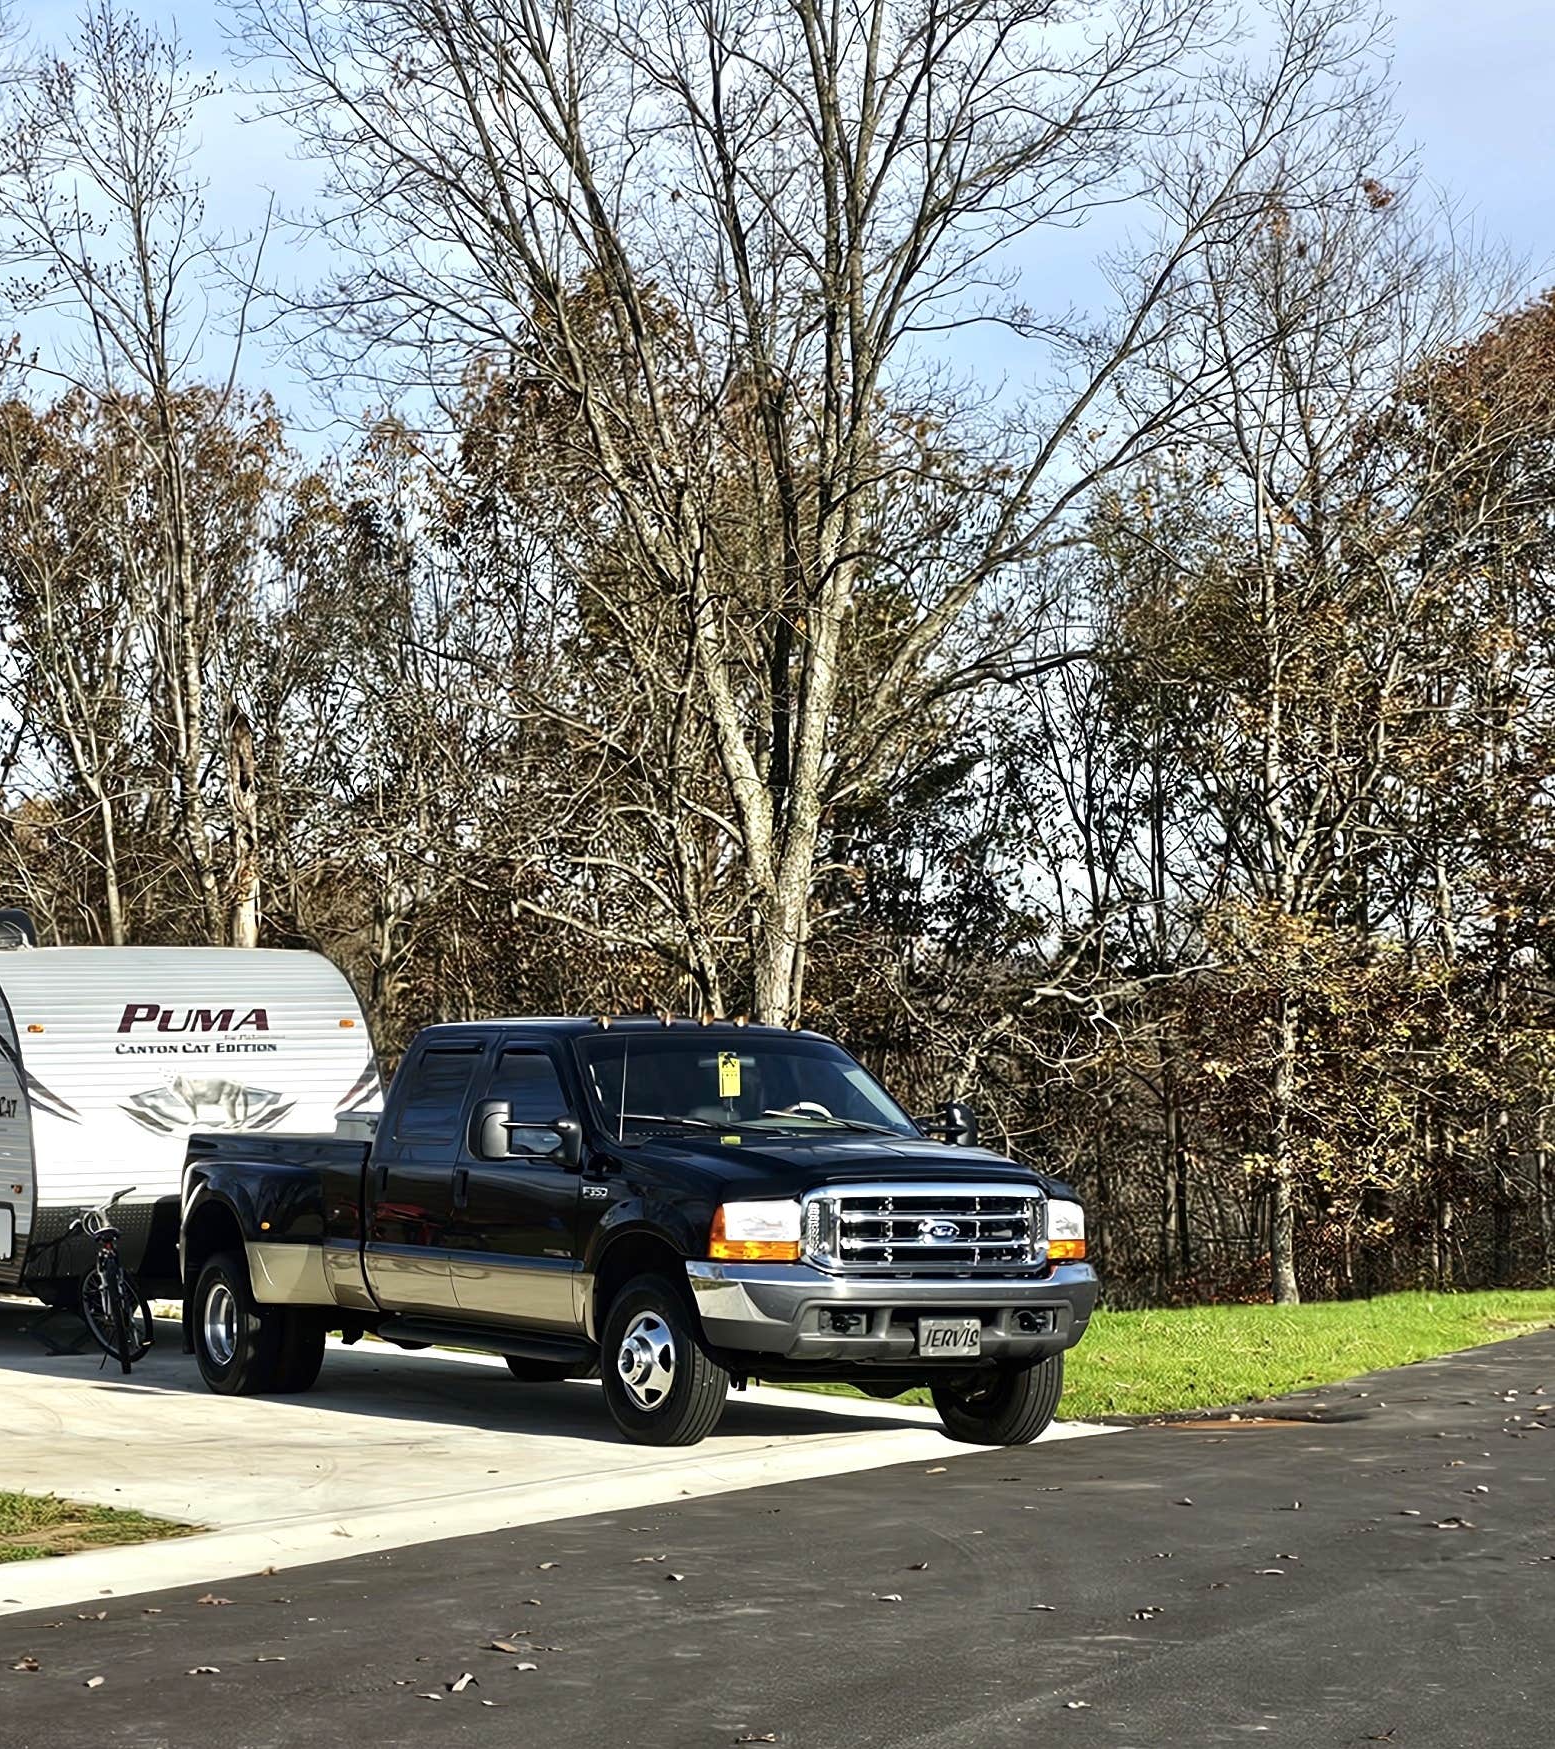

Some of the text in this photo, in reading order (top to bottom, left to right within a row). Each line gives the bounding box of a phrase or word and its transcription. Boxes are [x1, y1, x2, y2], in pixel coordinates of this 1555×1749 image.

[117, 1004, 269, 1033] PUMA
[115, 1042, 278, 1055] CANYON CAT EDITION
[920, 1328, 979, 1348] JERVIS
